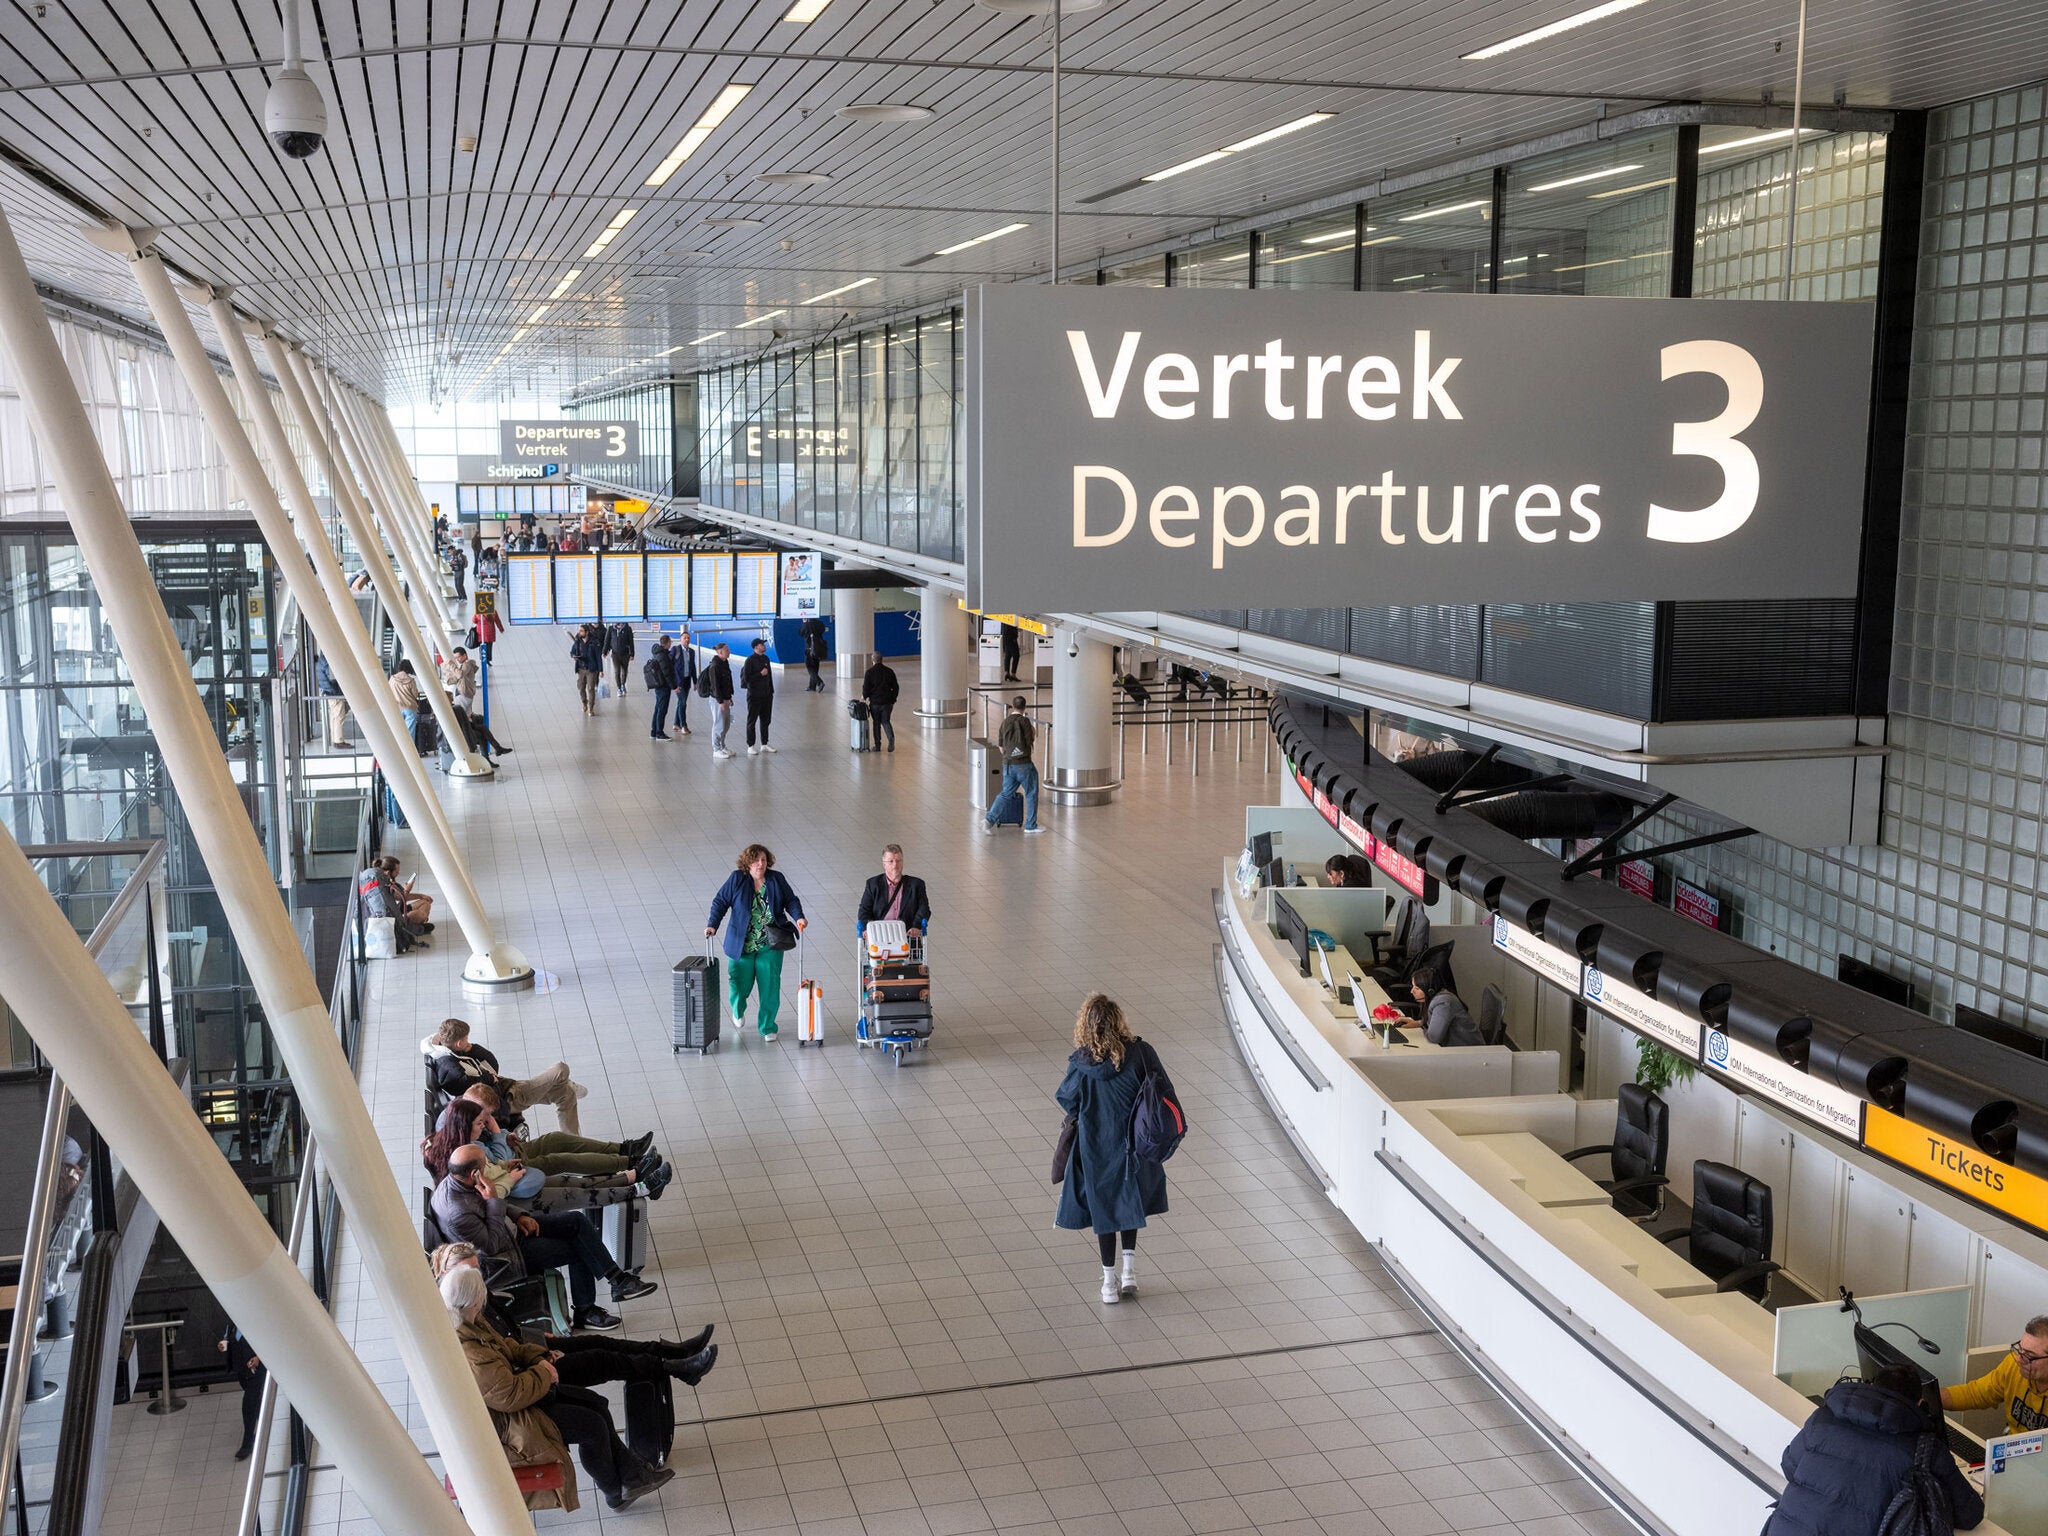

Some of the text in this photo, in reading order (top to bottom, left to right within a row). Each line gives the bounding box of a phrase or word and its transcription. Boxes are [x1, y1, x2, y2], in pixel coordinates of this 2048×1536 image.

[1066, 329, 1464, 421] Vertrek
[515, 425, 602, 442] Departures
[516, 443, 568, 456] Vertrek
[605, 425, 627, 457] 3
[1646, 339, 1766, 544] 3
[487, 463, 543, 479] Schiphol
[1071, 464, 1601, 570] Departures
[249, 600, 259, 613] B
[1677, 883, 1718, 914] ticketbook.nl
[1679, 900, 1713, 926] ALL AIRLINES
[1603, 991, 1613, 1002] IOM
[1613, 996, 1639, 1017] International
[1639, 1010, 1668, 1032] Organization
[1667, 1025, 1675, 1036] for
[1675, 1028, 1698, 1048] Migration
[1729, 1058, 1857, 1128] IOM International Organization for Migration
[1927, 1137, 2004, 1192] Tickets
